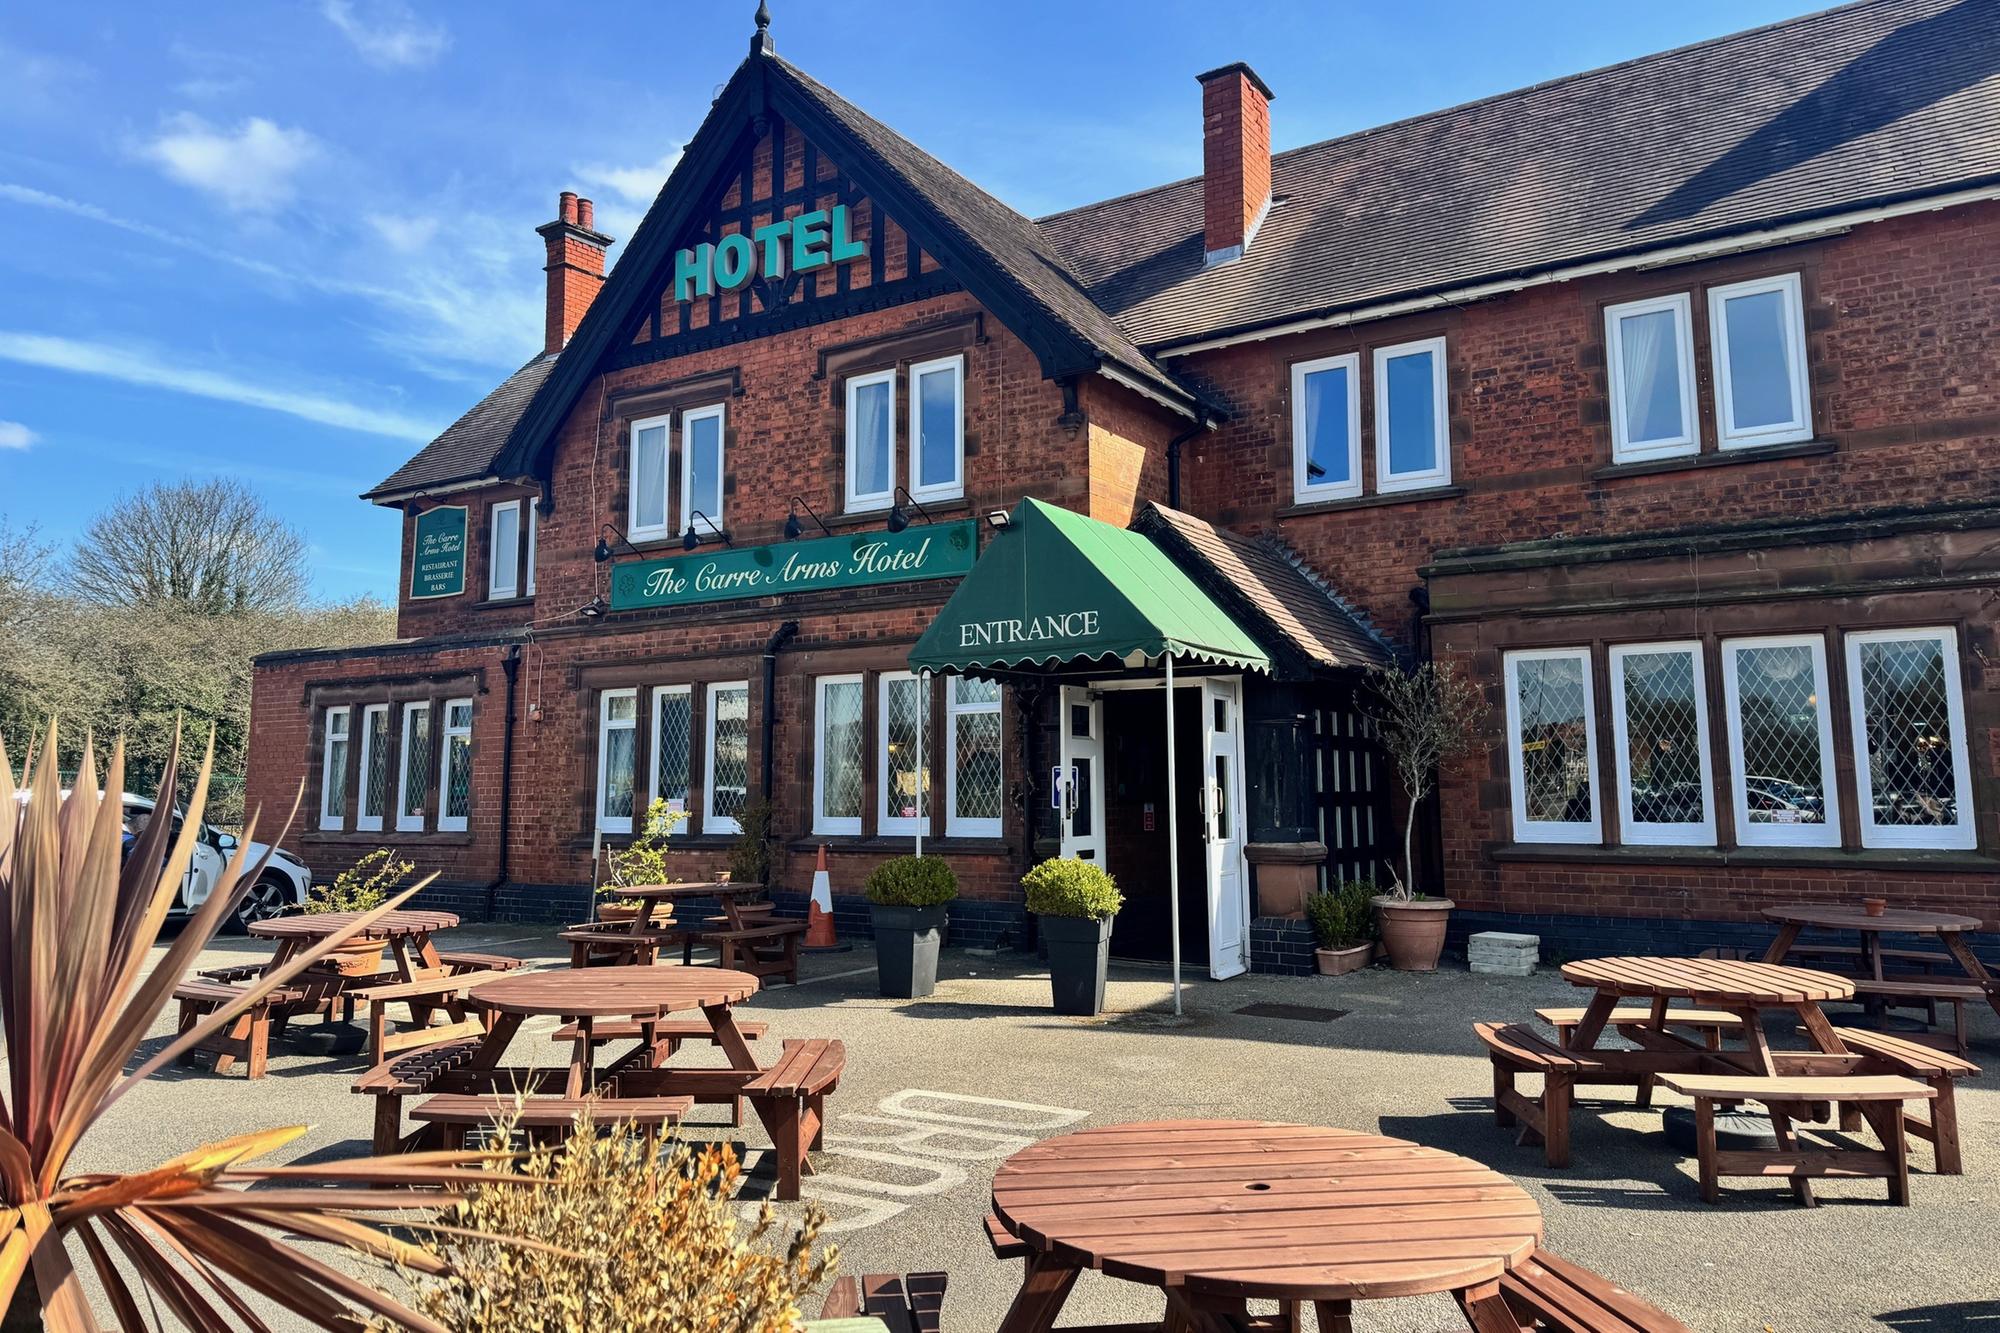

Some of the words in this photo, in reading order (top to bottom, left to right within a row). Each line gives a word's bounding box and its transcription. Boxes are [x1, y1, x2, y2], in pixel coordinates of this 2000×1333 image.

[674, 204, 870, 304] HOTEL
[422, 535, 437, 545] The
[438, 532, 459, 543] Carre
[419, 545, 440, 556] Arms
[441, 541, 462, 553] Hotel
[422, 560, 457, 571] RESTAURANT
[643, 568, 689, 597] The
[695, 562, 762, 592] Carre
[766, 552, 844, 585] Arms
[850, 538, 931, 575] Hotel
[424, 572, 454, 581] BRASSERIE
[430, 583, 447, 591] BARS
[959, 610, 1100, 647] ENTRANCE
